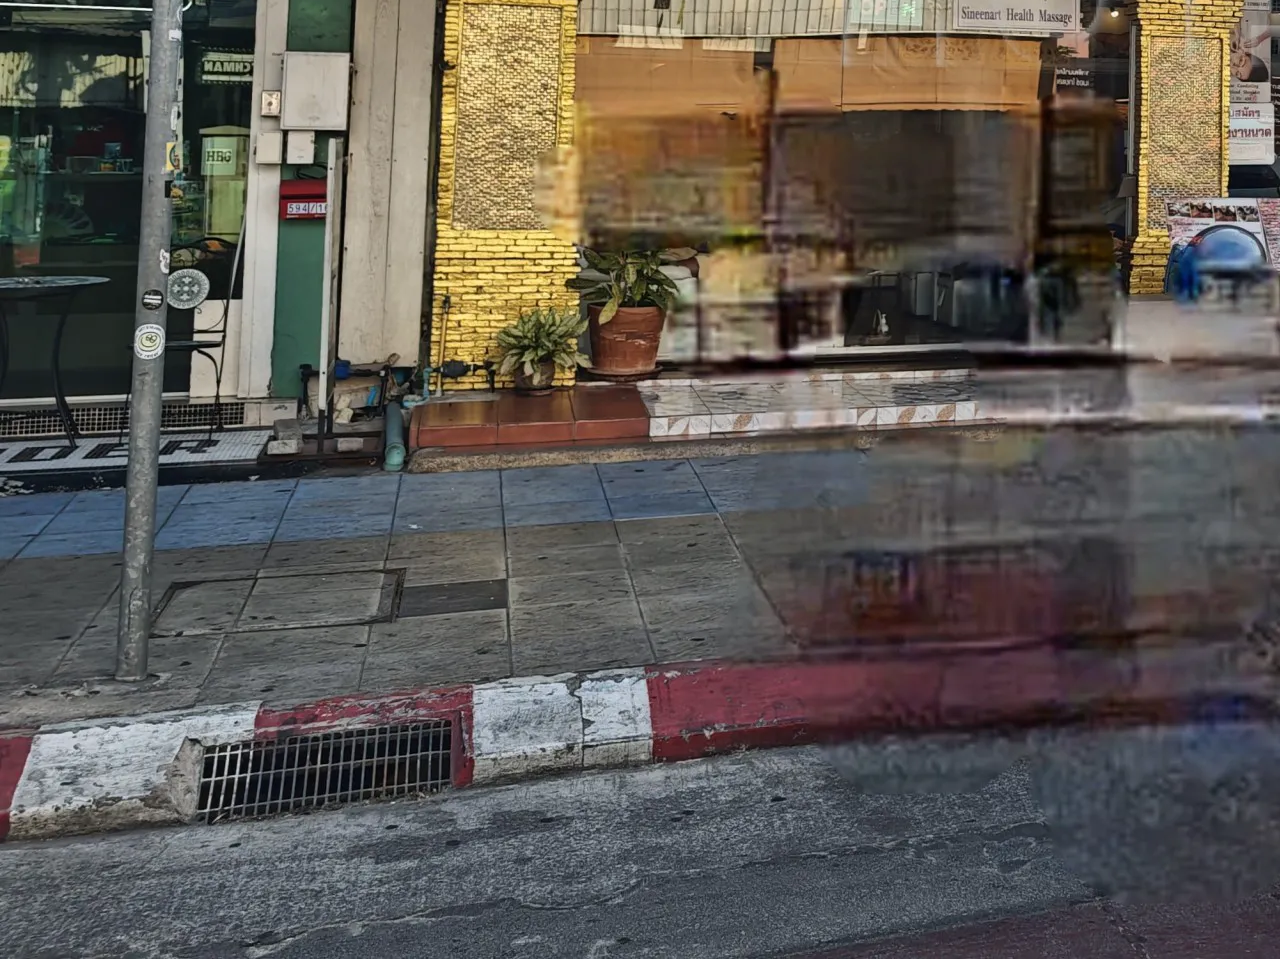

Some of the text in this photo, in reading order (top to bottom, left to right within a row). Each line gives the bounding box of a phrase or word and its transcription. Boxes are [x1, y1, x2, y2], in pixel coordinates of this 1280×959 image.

[961, 6, 1073, 27] Sineenart Health Massage
